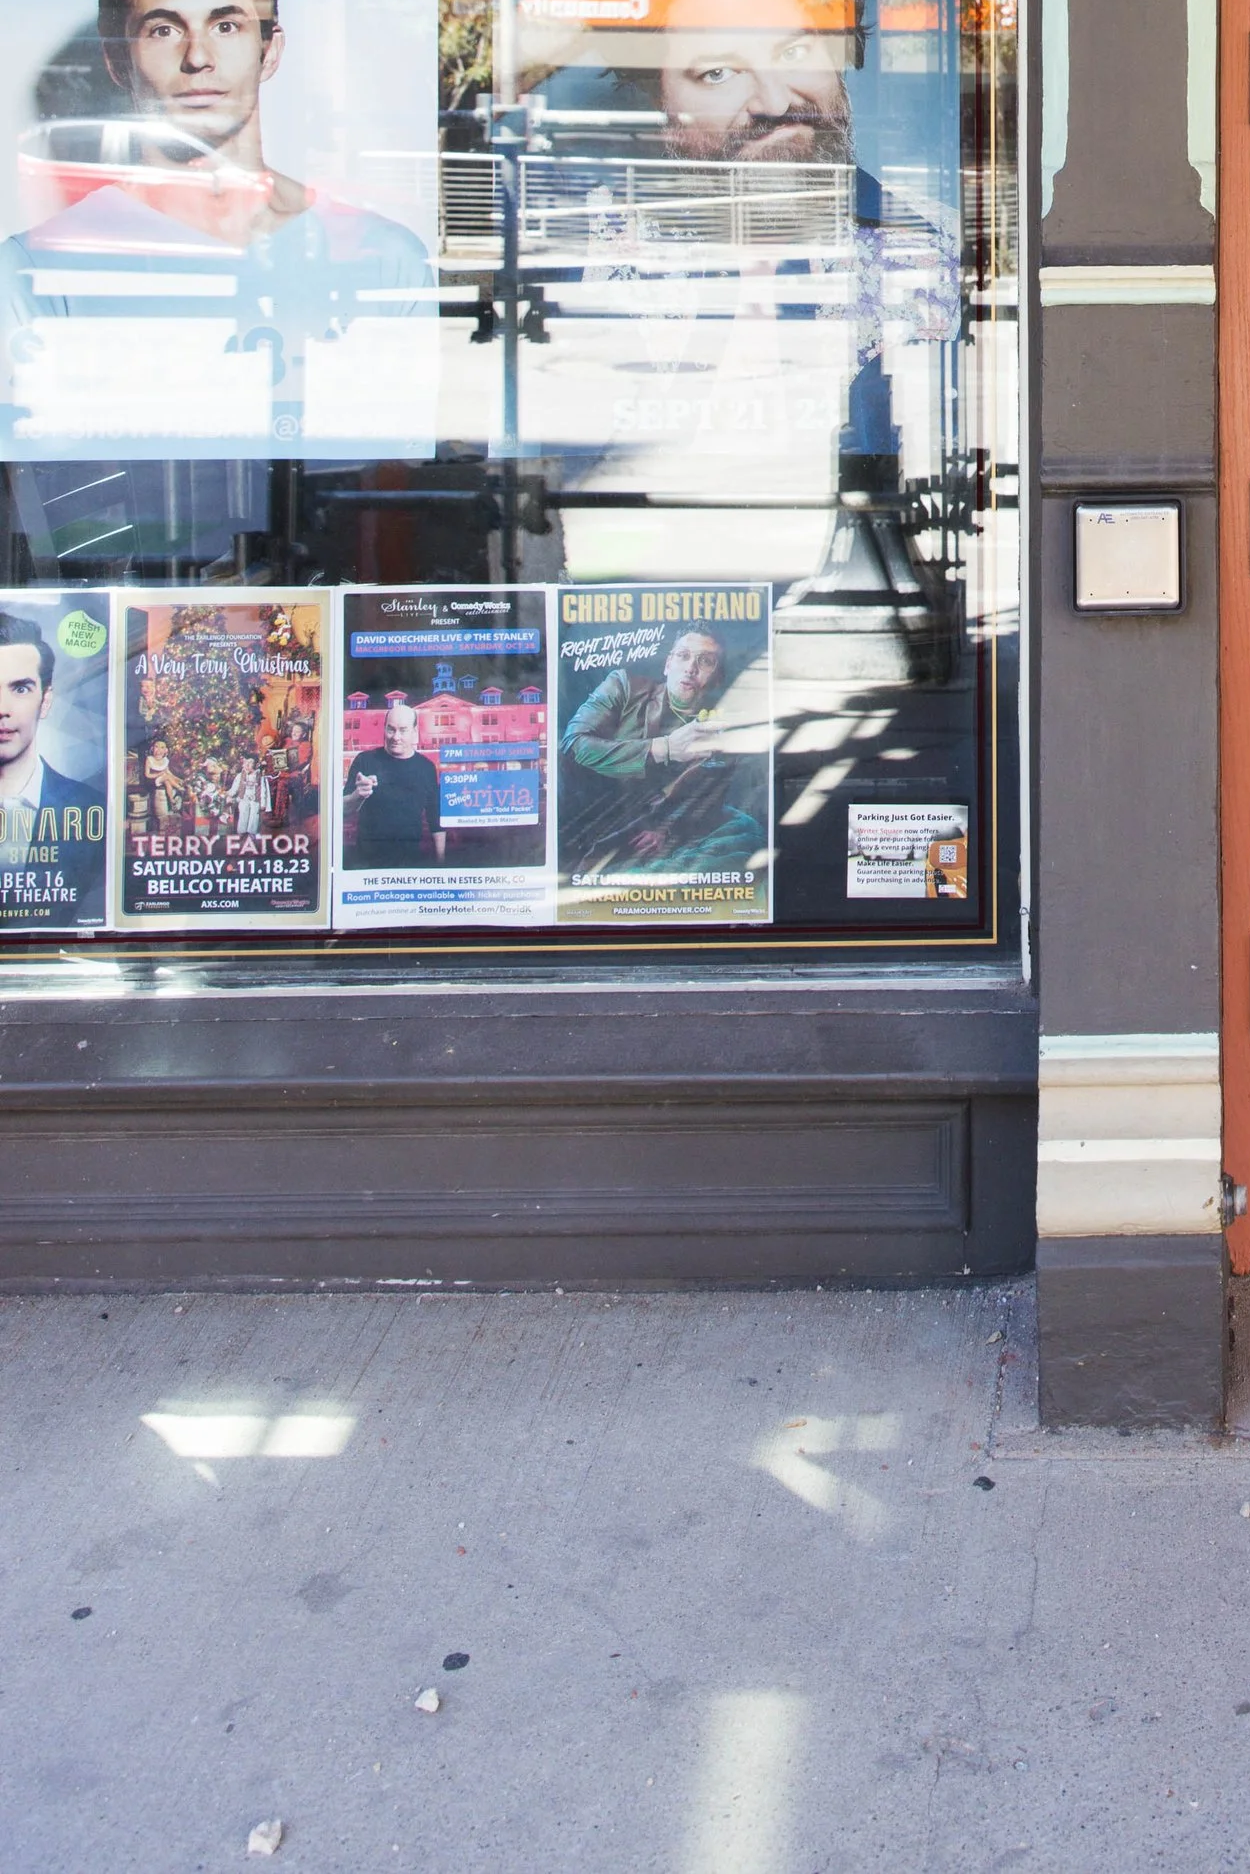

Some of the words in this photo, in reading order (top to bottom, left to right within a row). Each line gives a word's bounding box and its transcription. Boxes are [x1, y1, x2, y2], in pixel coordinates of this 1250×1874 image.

[381, 598, 437, 617] Stanley
[562, 593, 634, 623] CHRIS
[641, 592, 761, 622] DISTEFANO
[68, 622, 101, 632] FRESH
[71, 630, 94, 639] NEW
[356, 636, 387, 644] DAVID
[387, 634, 440, 643] KOECHNER
[441, 633, 462, 642] LIVE
[474, 633, 491, 641] THE
[492, 632, 535, 641] STANLEY
[65, 638, 97, 649] MAGIC
[561, 637, 602, 659] RIGHT
[574, 650, 624, 672] WRONG
[626, 642, 661, 663] MOVE
[134, 655, 148, 675] A
[151, 654, 188, 680] Very
[444, 749, 462, 757] 7PM
[444, 774, 477, 784] 9:30PM
[461, 784, 534, 808] trivia
[857, 814, 890, 822] Parking
[891, 814, 908, 822] Just
[927, 813, 955, 821] Easier.
[132, 834, 220, 858] TERRY
[226, 833, 310, 856] FATOR
[132, 860, 226, 877] SATURDAY
[237, 859, 311, 875] 11.18.23
[899, 868, 924, 876] parking
[44, 870, 64, 887] 16
[363, 877, 379, 885] THE
[380, 876, 418, 885] STANLEY
[419, 876, 445, 884] HOTEL
[447, 876, 457, 884] IN
[458, 876, 483, 884] ESTES
[744, 871, 754, 884] 9
[147, 878, 213, 895] BELLCO
[215, 877, 294, 894] THEATRE
[14, 887, 77, 903] THEATRE
[347, 893, 371, 902] Room
[373, 892, 415, 904] Packages
[417, 891, 455, 901] available
[458, 891, 475, 900] with
[681, 886, 755, 902] THEATRE
[200, 900, 240, 909] AXS.COM
[613, 905, 713, 915] PARAMOUNTDENVER.COM
